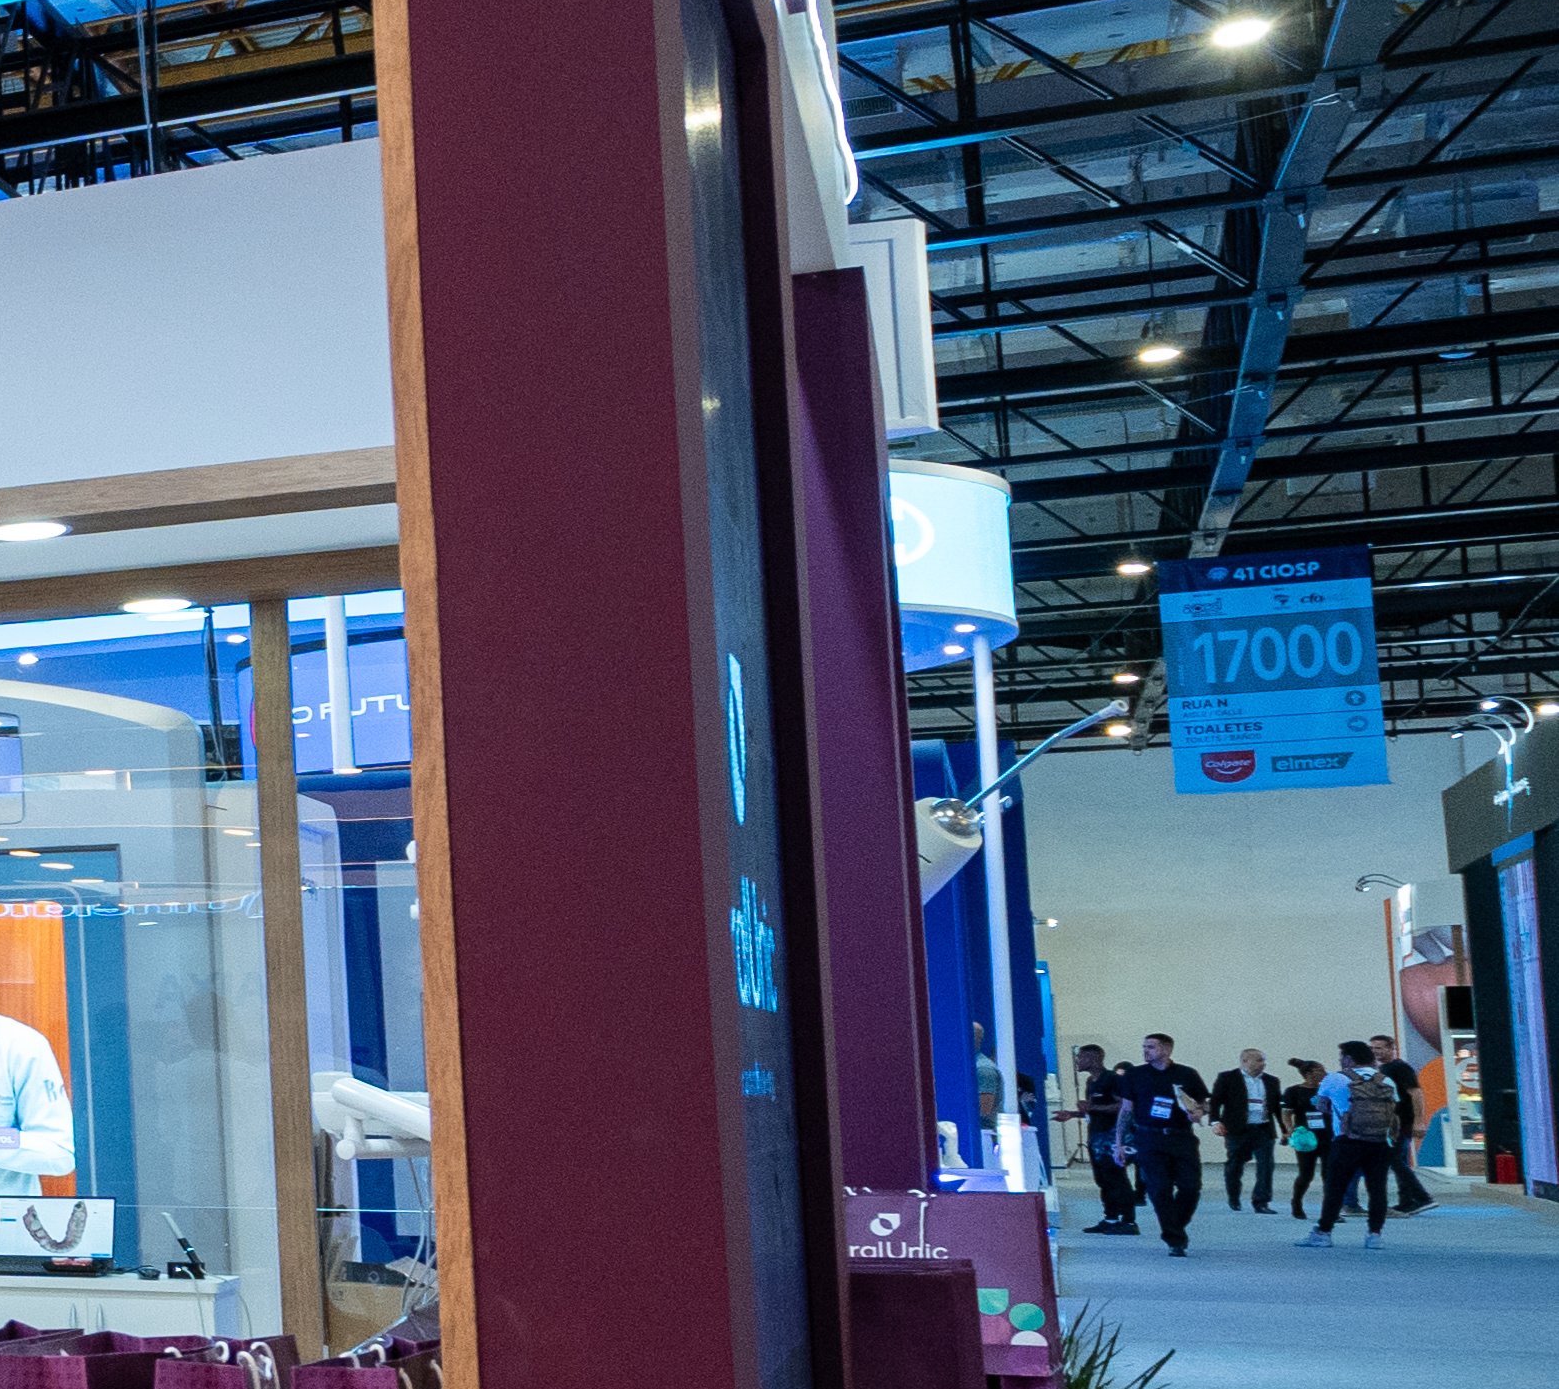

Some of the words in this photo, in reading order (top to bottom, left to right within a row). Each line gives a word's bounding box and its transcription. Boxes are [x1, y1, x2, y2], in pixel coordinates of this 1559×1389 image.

[1233, 568, 1254, 581] 41
[1259, 561, 1320, 580] CIOSP
[1193, 621, 1363, 684] 17000
[1182, 700, 1214, 710] RUA
[1217, 698, 1228, 707] N
[1184, 721, 1263, 735] TOALETES
[1205, 758, 1252, 769] Colgate
[1276, 756, 1339, 771] elmex
[848, 1241, 949, 1259] ralUnic
